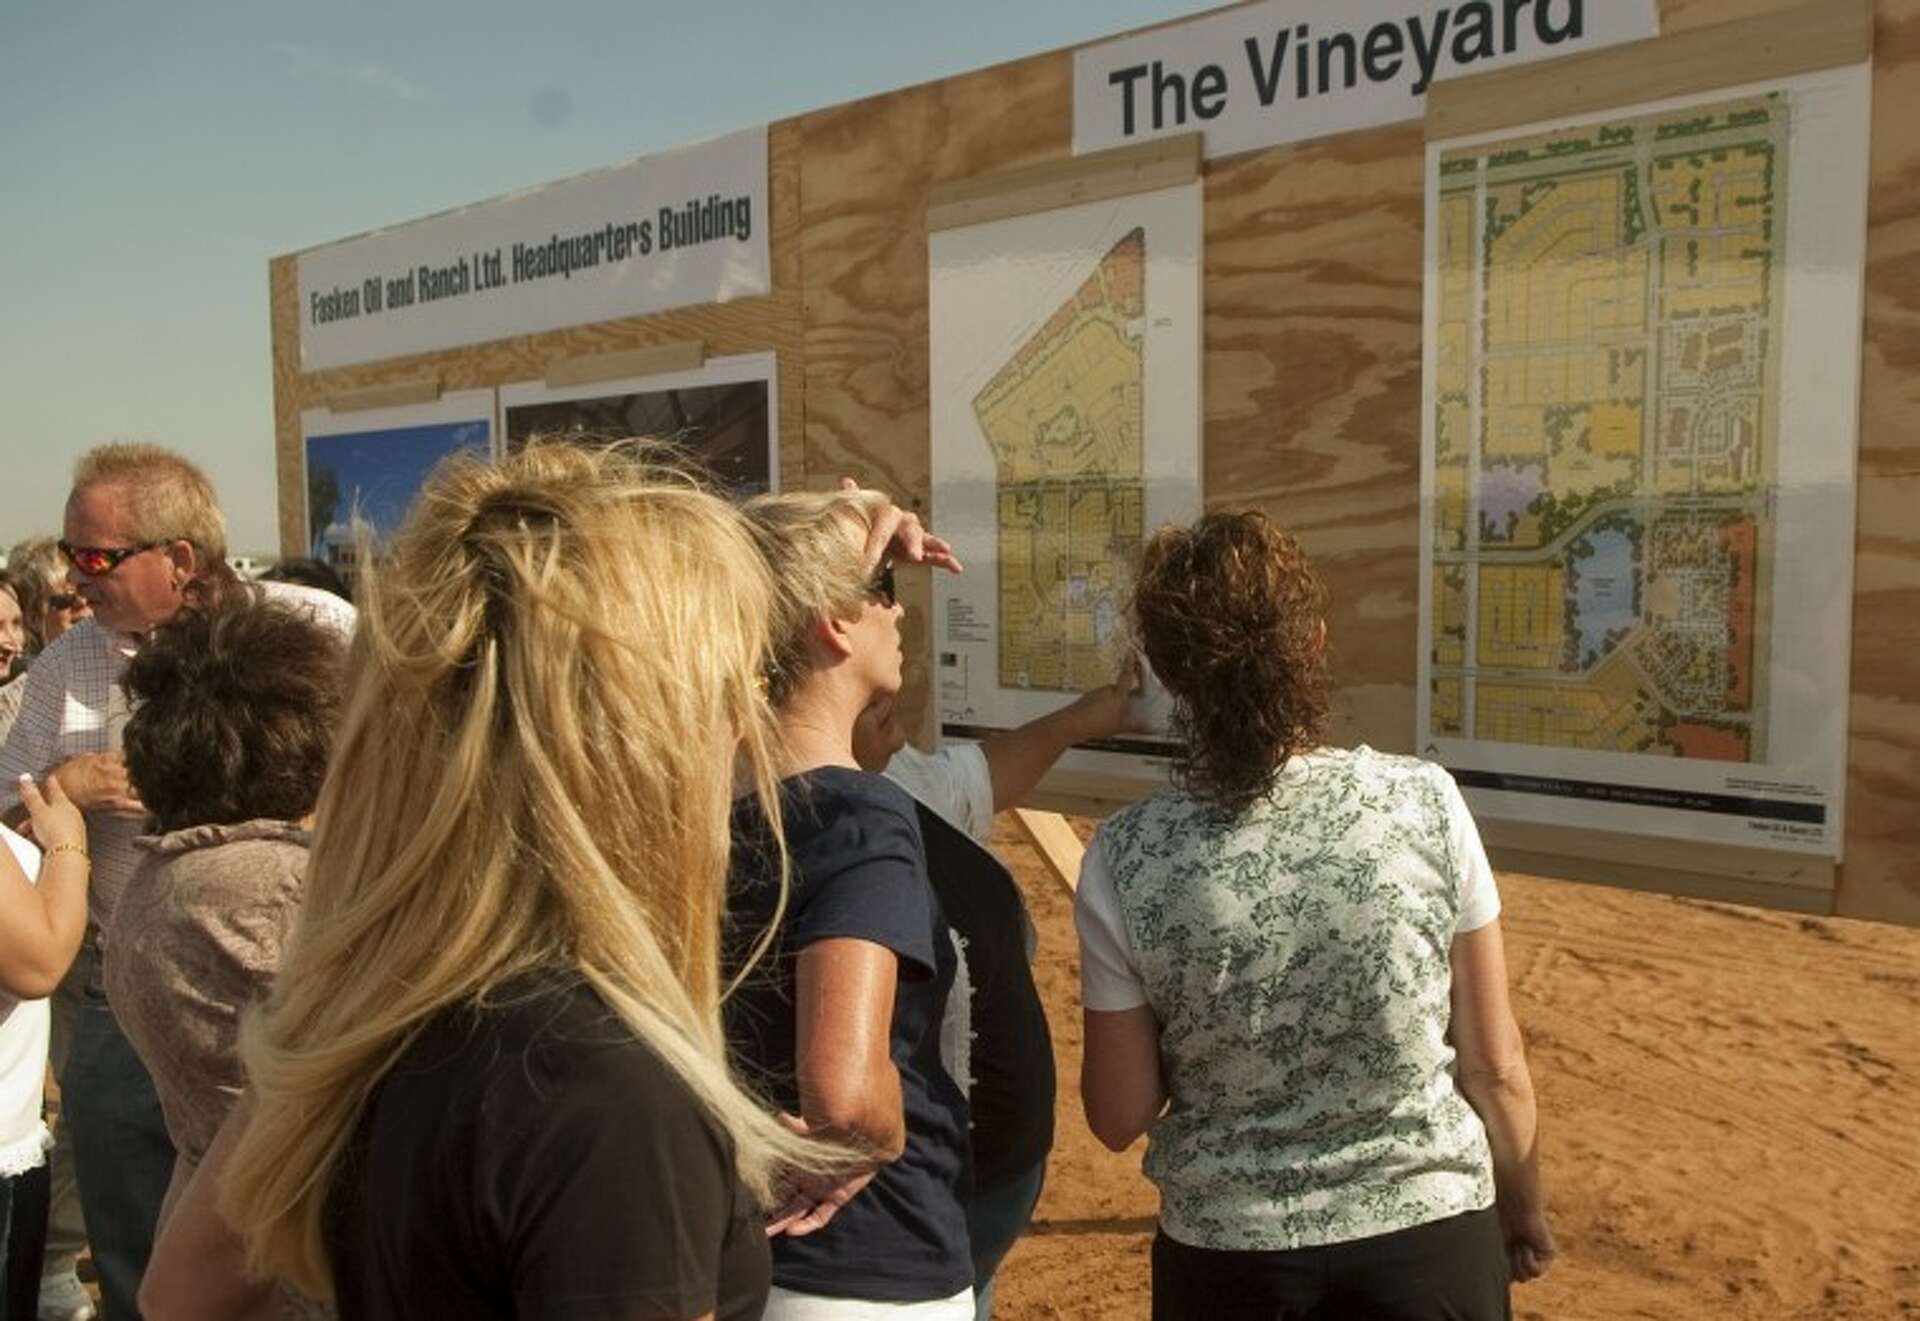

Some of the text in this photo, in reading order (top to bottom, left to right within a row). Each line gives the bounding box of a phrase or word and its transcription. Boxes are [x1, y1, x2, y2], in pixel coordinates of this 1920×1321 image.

[1109, 0, 1584, 136] The Vineyard
[310, 194, 751, 326] Fasken Oil and Ranch Ltd. Headquarters Building
